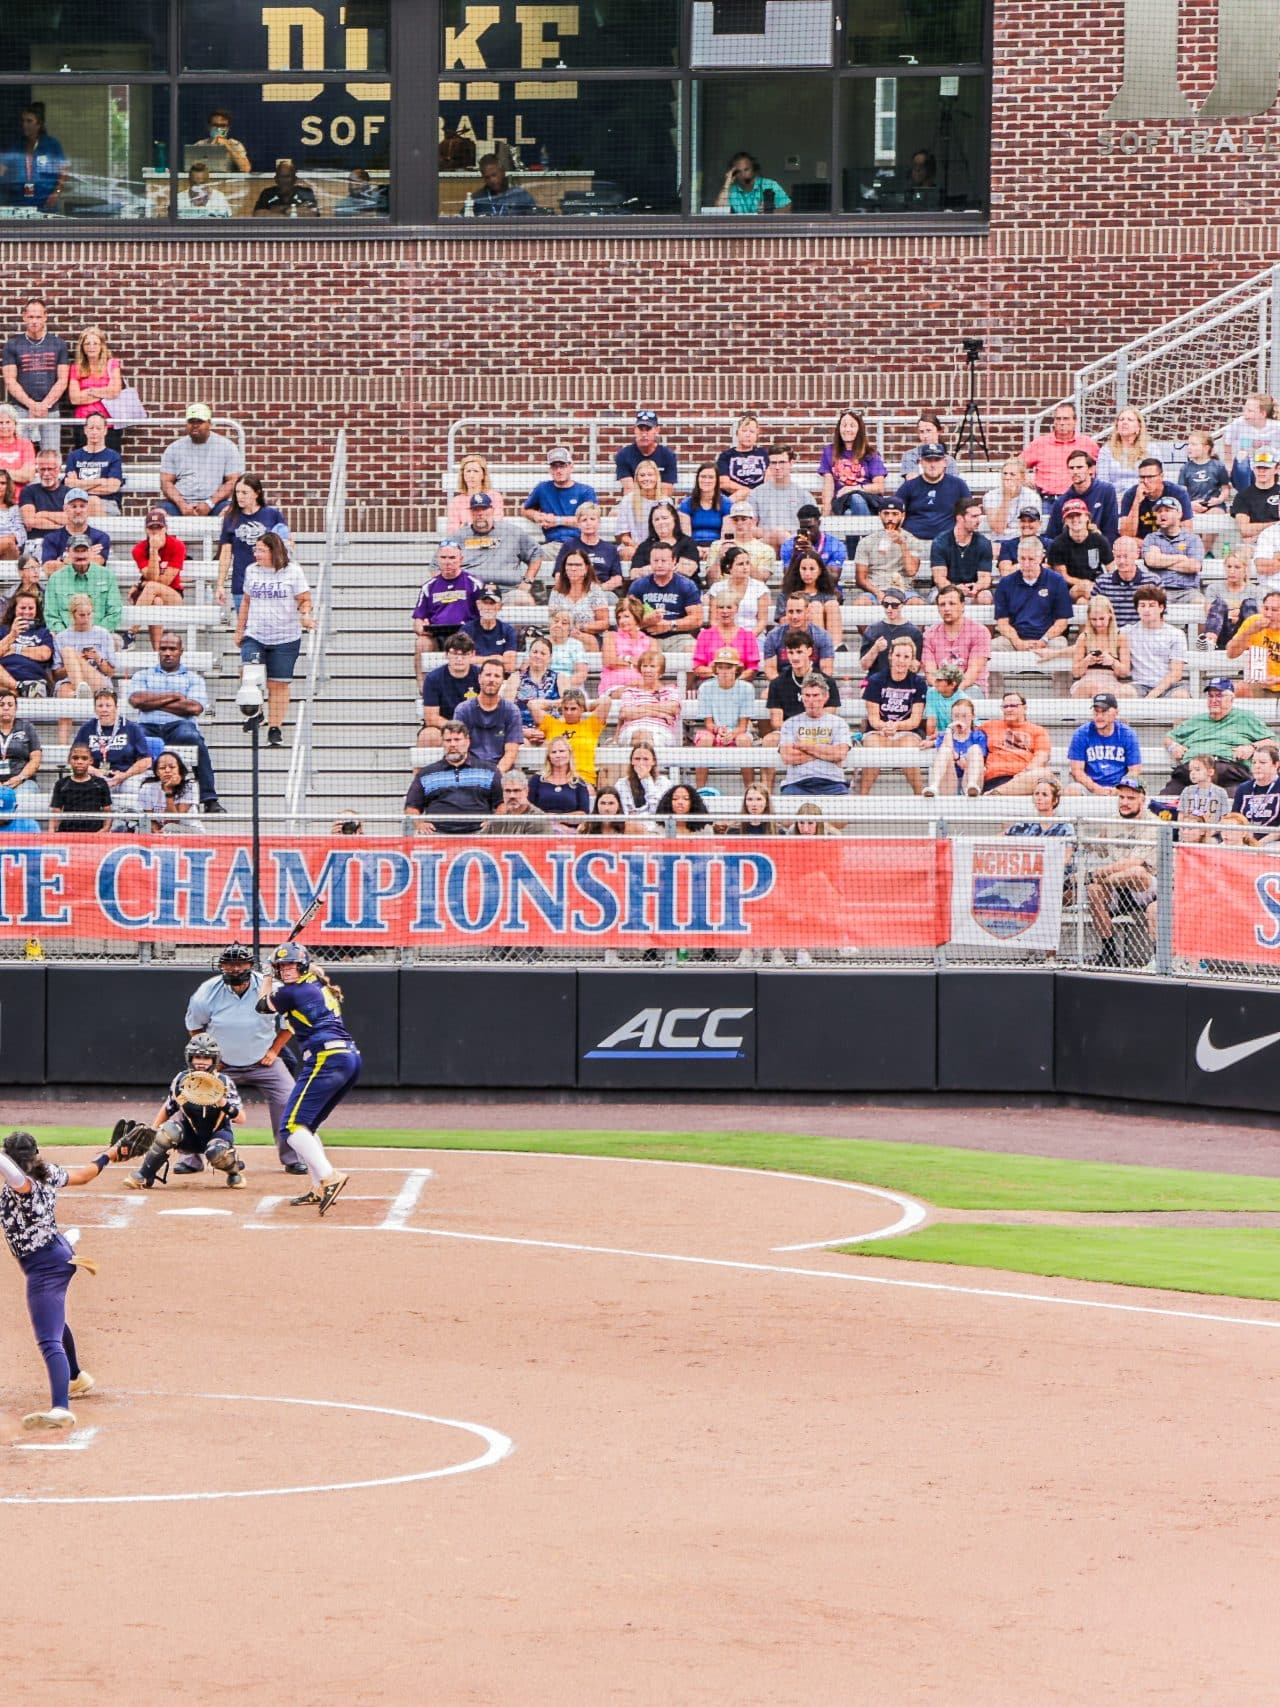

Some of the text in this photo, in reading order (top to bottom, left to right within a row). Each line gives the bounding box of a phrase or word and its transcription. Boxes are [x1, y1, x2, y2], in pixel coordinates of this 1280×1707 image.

[301, 115, 536, 146] SOFALL
[1097, 129, 1280, 157] SOFTBALL
[253, 582, 283, 590] EAST
[643, 592, 679, 604] PREPARE
[1086, 745, 1125, 762] DUKE
[973, 851, 1044, 875] NCHSAA
[95, 845, 777, 936] CHAMPIONSHIP
[597, 1007, 754, 1048] ACC
